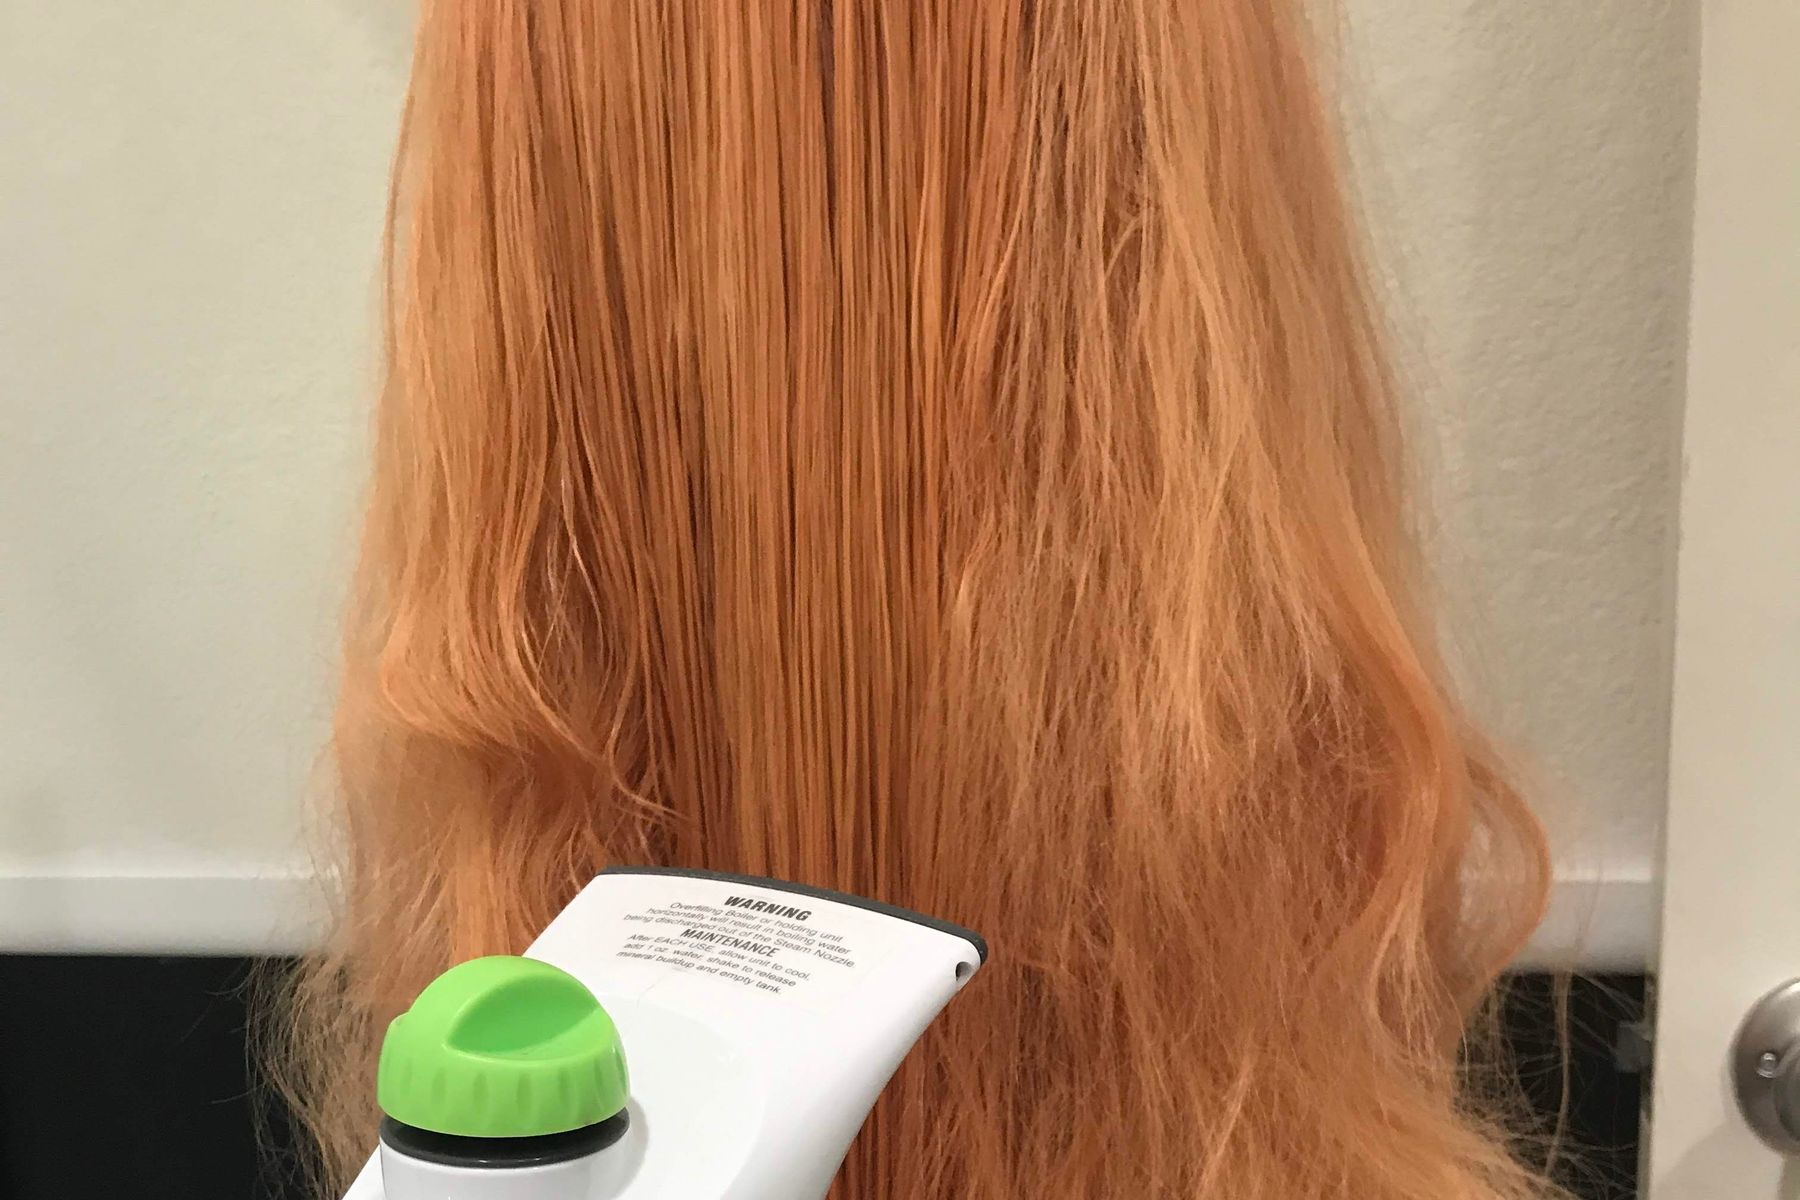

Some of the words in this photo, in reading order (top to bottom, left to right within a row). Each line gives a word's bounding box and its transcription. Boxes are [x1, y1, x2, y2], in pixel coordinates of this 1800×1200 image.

[670, 902, 723, 916] Overfilling
[725, 909, 758, 921] Boiler
[774, 920, 818, 937] holding
[819, 932, 844, 943] unit
[724, 896, 812, 921] WARNING
[623, 914, 654, 923] being
[655, 916, 717, 930] discharged
[773, 938, 812, 954] Steam
[647, 908, 706, 920] horizontally
[729, 919, 762, 931] result
[776, 930, 816, 946] boiling
[818, 941, 851, 955] water
[680, 928, 780, 958] MAINTENANCE
[627, 934, 653, 942] After
[654, 936, 688, 946] EACH
[717, 949, 747, 960] allow
[748, 956, 772, 967] unit
[616, 951, 656, 960] mineral
[656, 955, 695, 969] buildup
[696, 964, 720, 974] and
[719, 971, 755, 986] empty
[706, 957, 740, 969] shake
[755, 970, 796, 987] release
